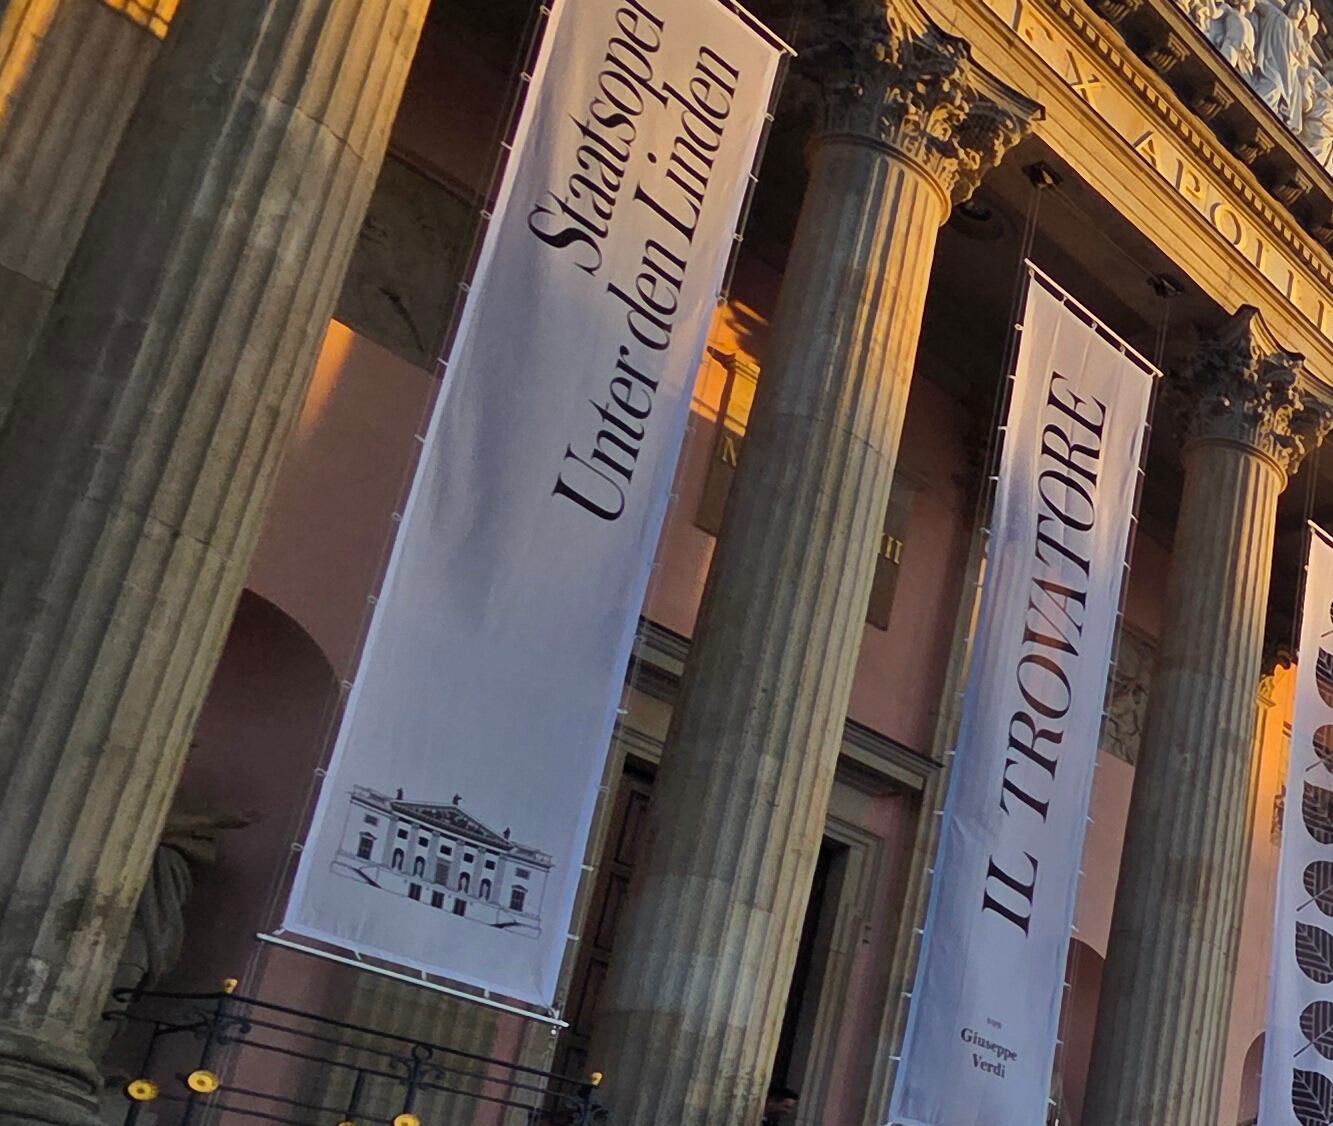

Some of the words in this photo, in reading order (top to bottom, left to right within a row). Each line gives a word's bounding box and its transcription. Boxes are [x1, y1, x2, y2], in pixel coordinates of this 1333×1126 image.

[633, 45, 740, 247] Linden
[606, 237, 688, 353] den
[552, 345, 660, 521] Unter
[999, 371, 1106, 824] TROVATORE
[981, 851, 1038, 938] IL
[960, 1027, 1018, 1062] Giuseppe
[972, 1053, 1006, 1079] Verdi
